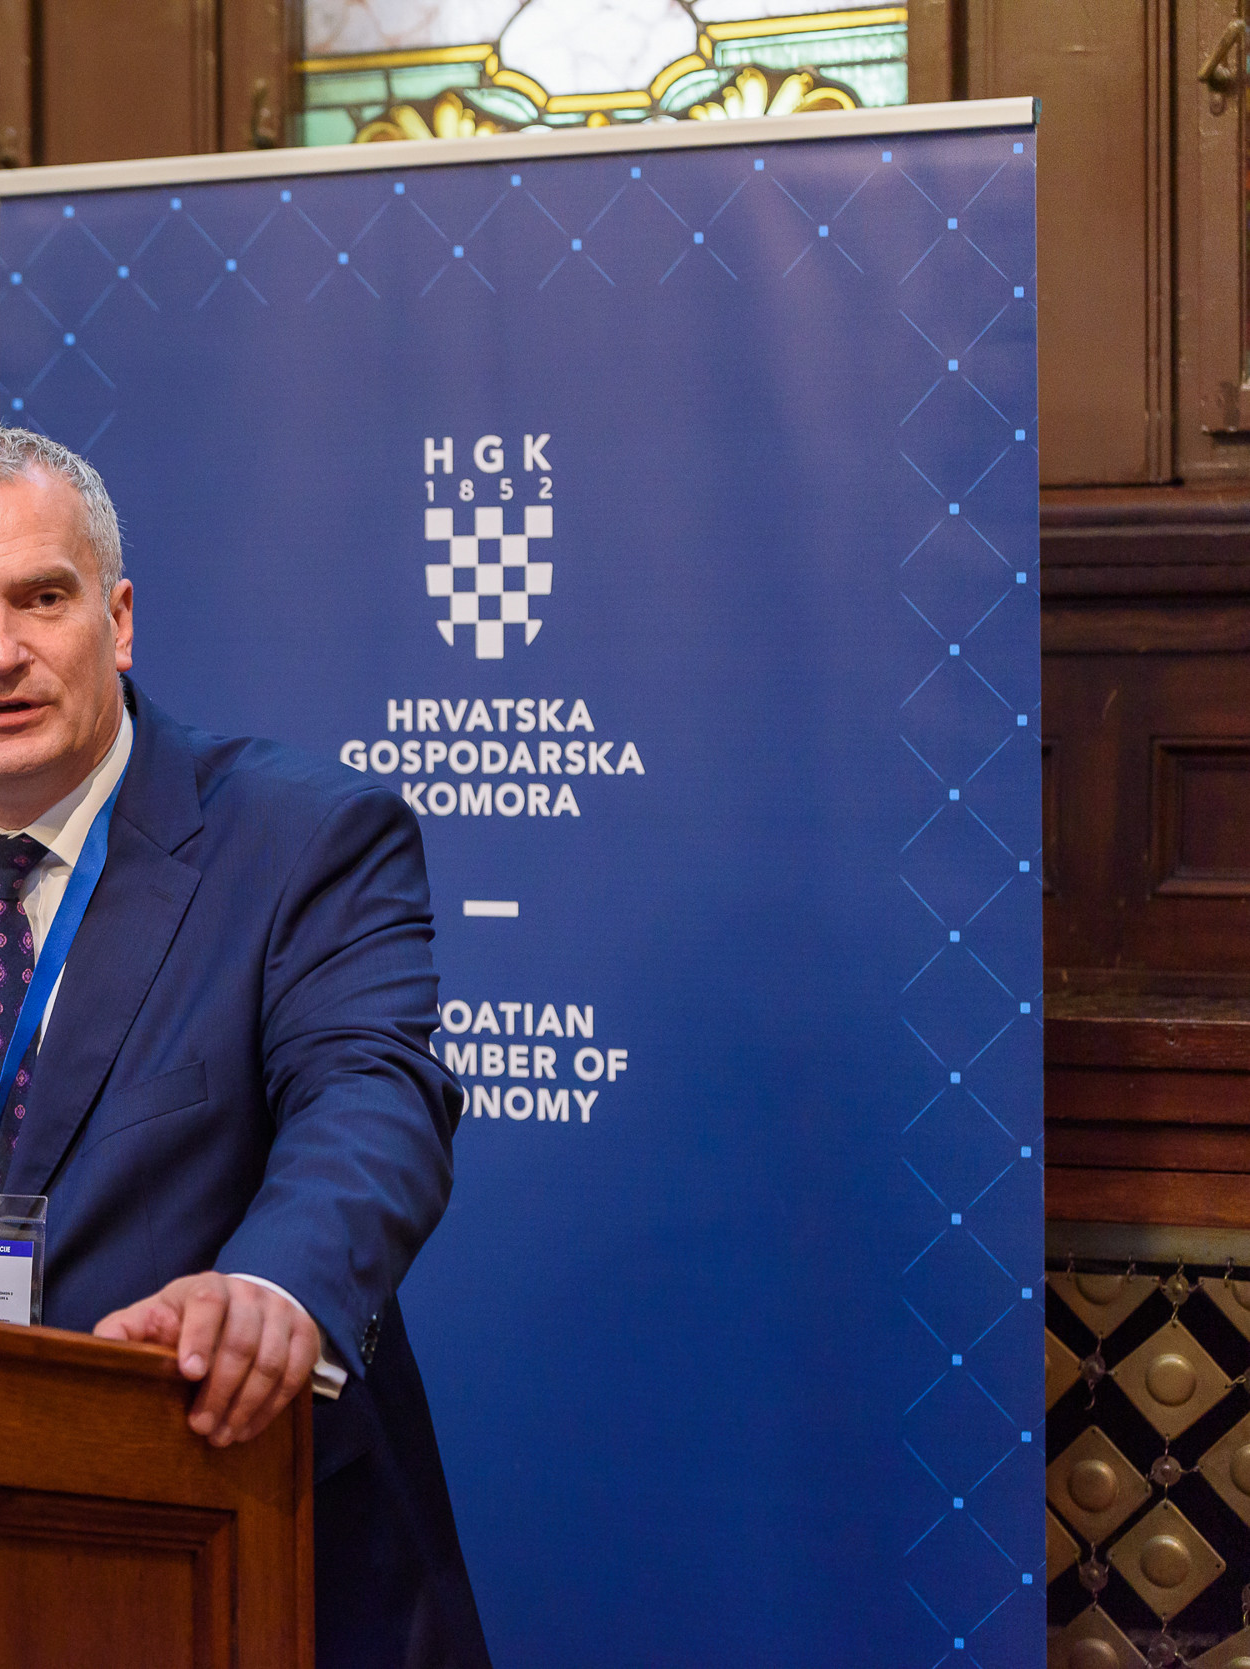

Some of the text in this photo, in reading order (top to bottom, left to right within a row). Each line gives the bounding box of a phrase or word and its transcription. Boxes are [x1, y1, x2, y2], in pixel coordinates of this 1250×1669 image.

[387, 698, 595, 733] HRVATSKA
[339, 739, 645, 775] GOSPODARSKA
[402, 782, 581, 817] KOMORA
[434, 1000, 594, 1038] OATIAN
[429, 1042, 628, 1082] MBER OF
